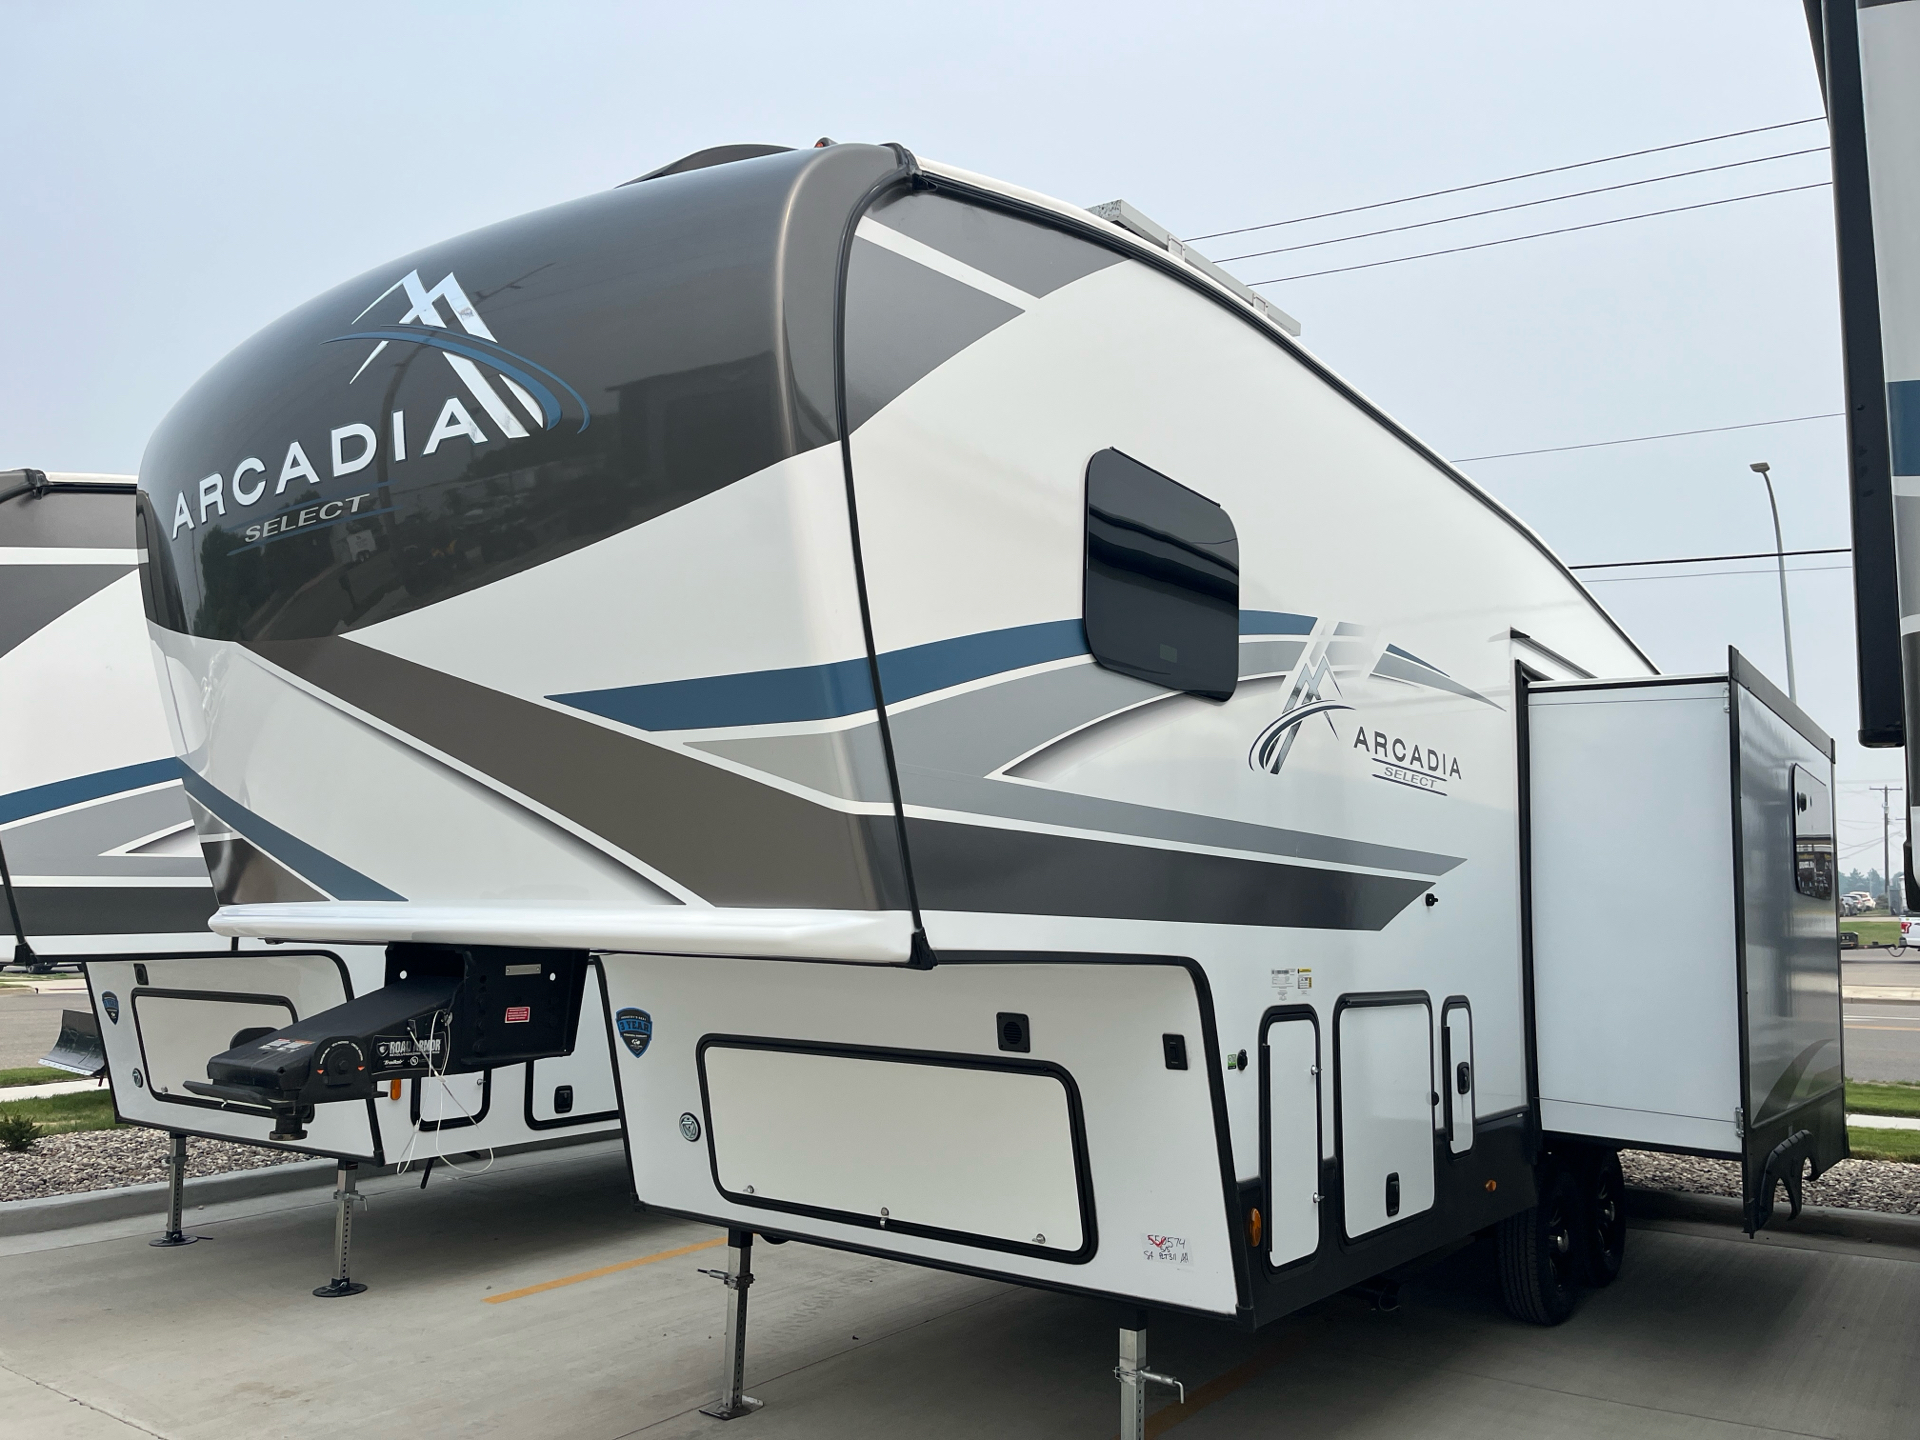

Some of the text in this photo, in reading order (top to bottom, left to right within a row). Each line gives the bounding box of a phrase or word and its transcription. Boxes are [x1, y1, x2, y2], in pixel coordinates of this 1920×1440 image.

[171, 396, 488, 541] ARCADIA
[244, 492, 370, 544] SELECT
[1353, 726, 1462, 780] ARCADIA
[1383, 766, 1438, 790] SELECT
[619, 1021, 650, 1032] 3 YEAR
[389, 1041, 412, 1054] ROAD
[413, 1039, 441, 1052] ARMOR
